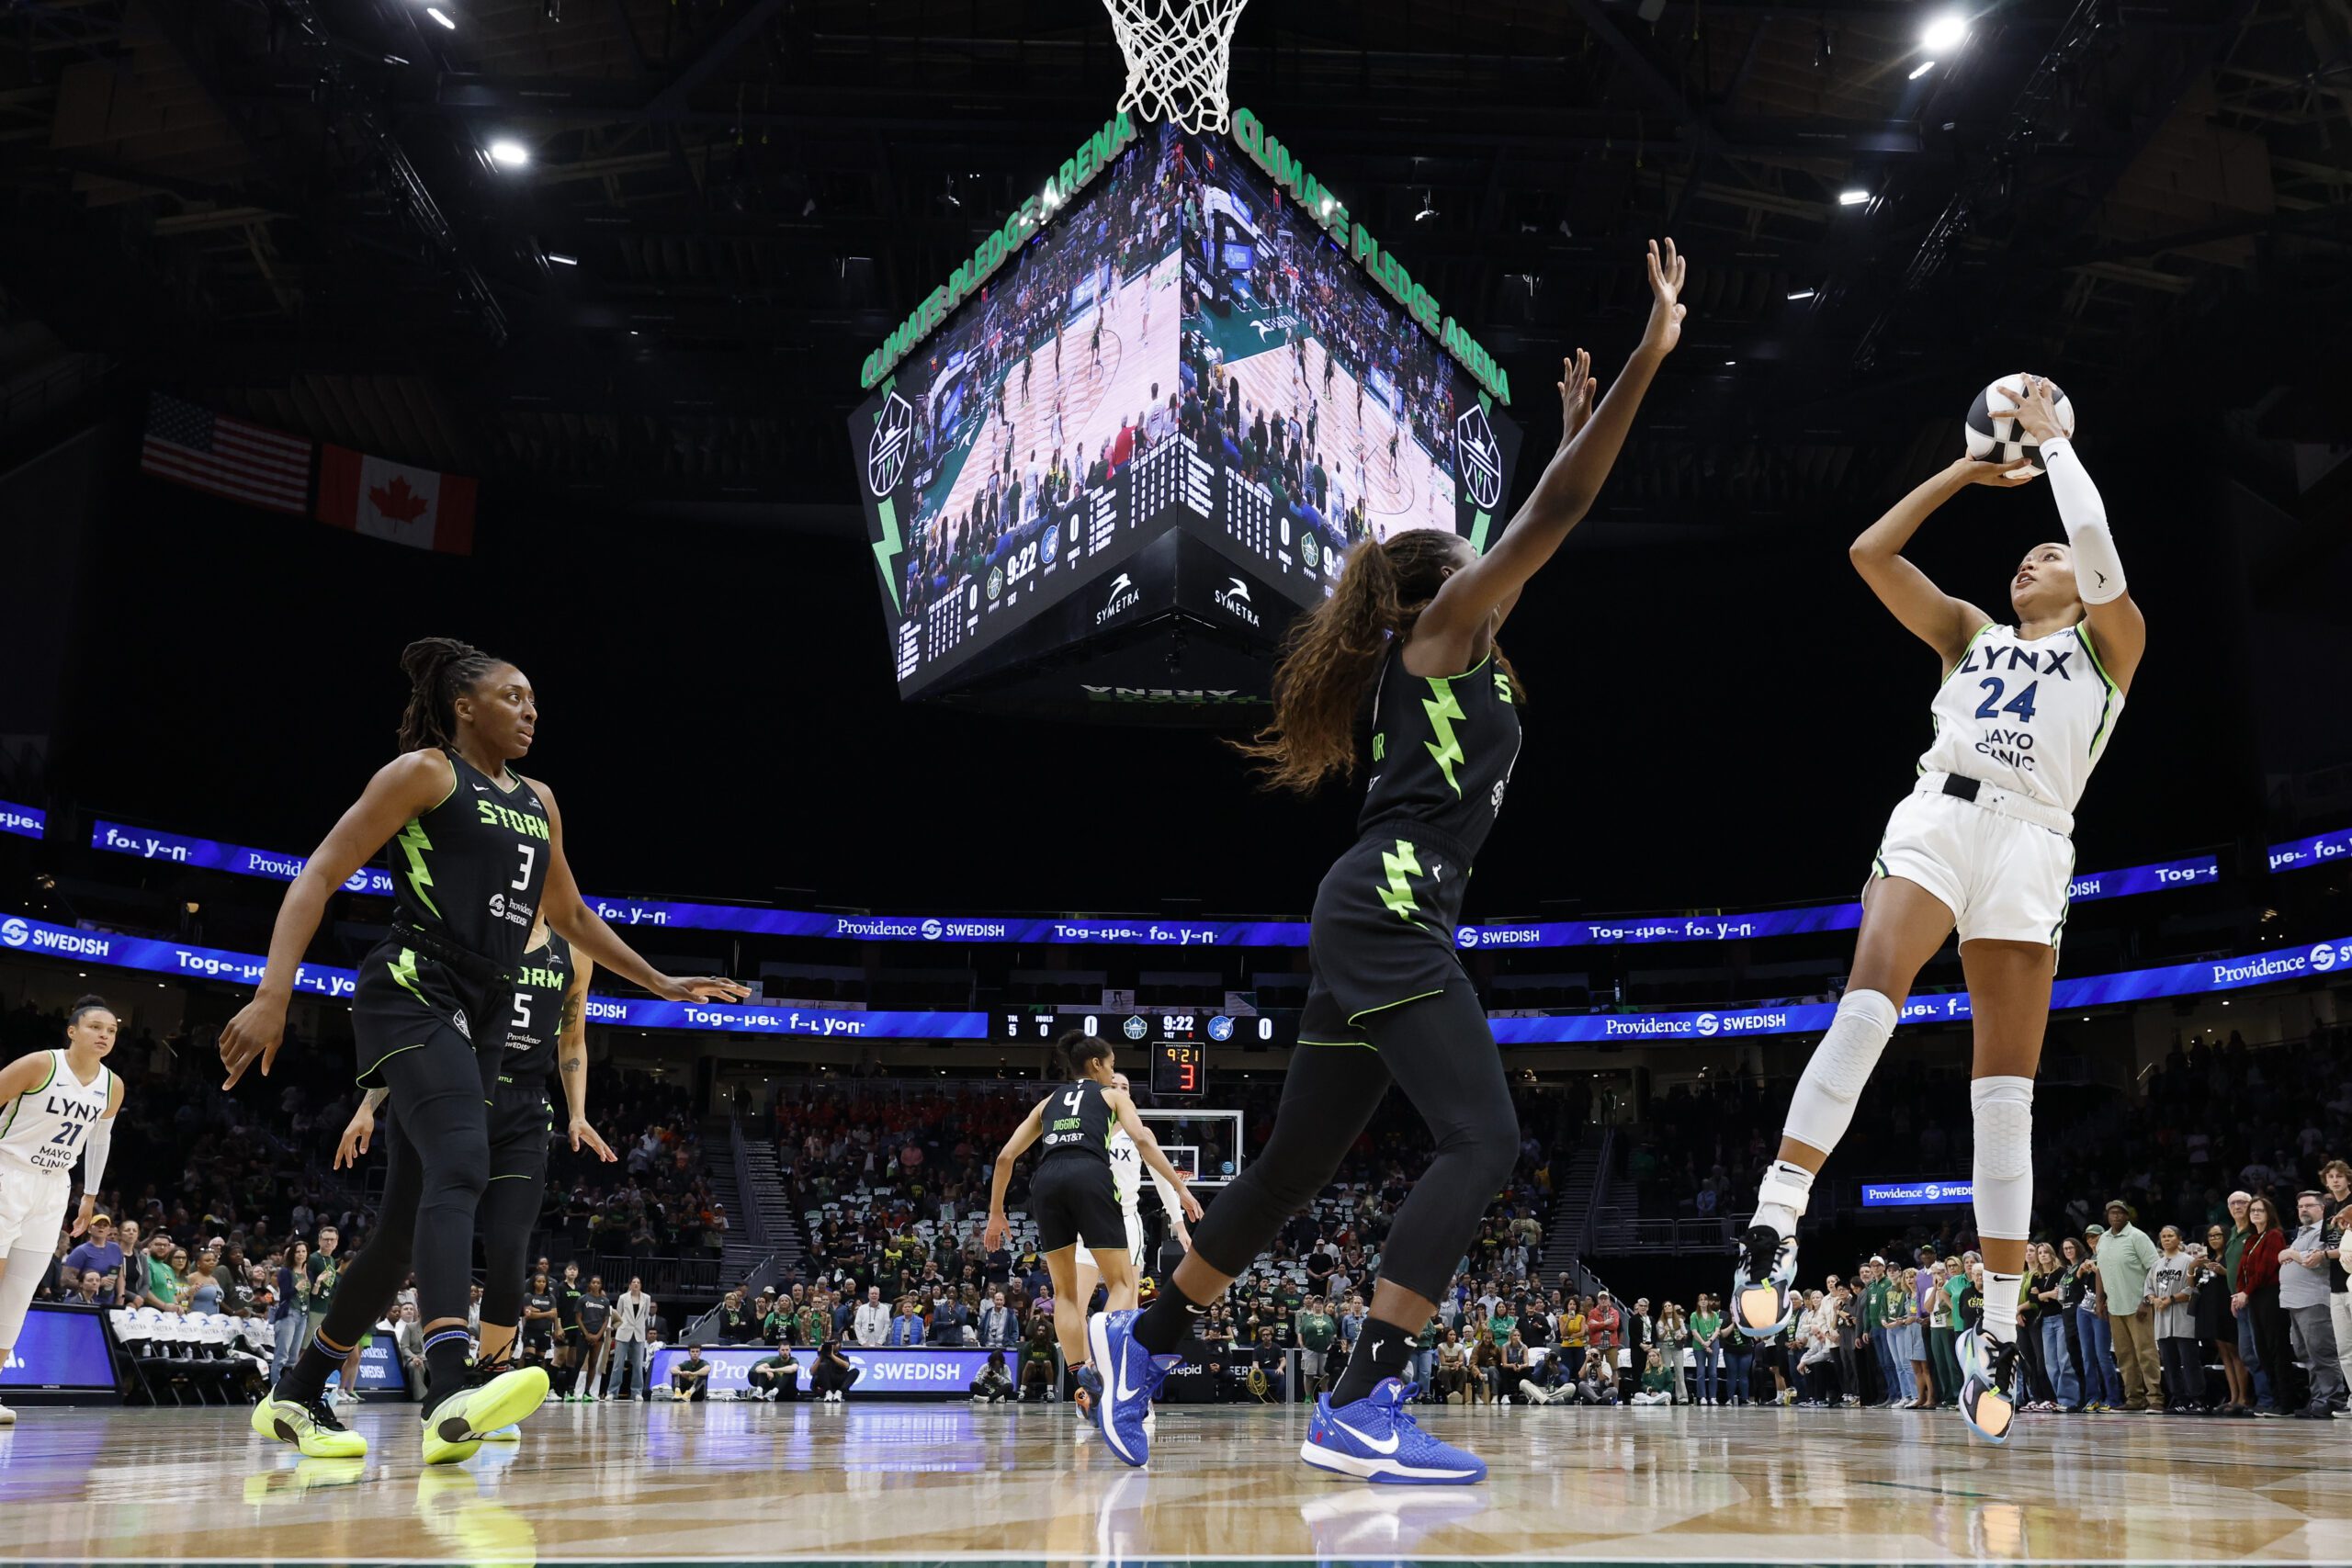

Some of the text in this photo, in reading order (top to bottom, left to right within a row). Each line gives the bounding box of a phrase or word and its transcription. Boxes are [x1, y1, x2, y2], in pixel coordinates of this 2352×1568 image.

[861, 112, 1136, 388] CLIMATE PLEDGE ARENA
[1233, 107, 1510, 406] CLIMATE PLEDGE ARENA
[1070, 513, 1080, 543] 0
[1280, 517, 1291, 547] 0
[1007, 540, 1037, 586] 9:22
[969, 584, 978, 611] 0
[1096, 589, 1139, 625] SYMETRA
[1215, 590, 1260, 627] SYMETRA
[1961, 645, 2073, 681] LYNX
[1975, 677, 2038, 723] 24
[477, 800, 550, 844] STORM
[512, 843, 535, 891] 3
[2069, 880, 2100, 897] DISH
[837, 919, 1005, 938] Providence SWEDISH
[1482, 929, 1540, 944] SWEDISH
[33, 929, 109, 956] SWEDISH
[517, 966, 564, 991] ORM
[2213, 954, 2305, 983] Providence
[511, 992, 533, 1028] 5
[585, 1002, 627, 1020] EDISH
[1009, 1024, 1016, 1036] 5
[1040, 1024, 1048, 1037] 0
[1035, 1015, 1053, 1023] FOULS
[1084, 1015, 1097, 1037] 0
[1163, 1015, 1194, 1031] 9:22
[1259, 1018, 1272, 1040] 0
[1606, 1013, 1786, 1035] Providence SWEDISH
[1167, 1048, 1198, 1063] 9:21
[1180, 1064, 1194, 1089] 3
[45, 1096, 102, 1124] LYNX
[1063, 1090, 1084, 1116] 4
[51, 1122, 84, 1146] 21
[1053, 1117, 1081, 1131] DIGGINS
[1059, 1133, 1085, 1143] AT&T
[40, 1145, 72, 1161] MAYO
[1110, 1148, 1131, 1162] NX
[1869, 1188, 1923, 1200] Providence
[359, 1365, 386, 1379] SWEDISH
[874, 1362, 960, 1381] SWEDISH
